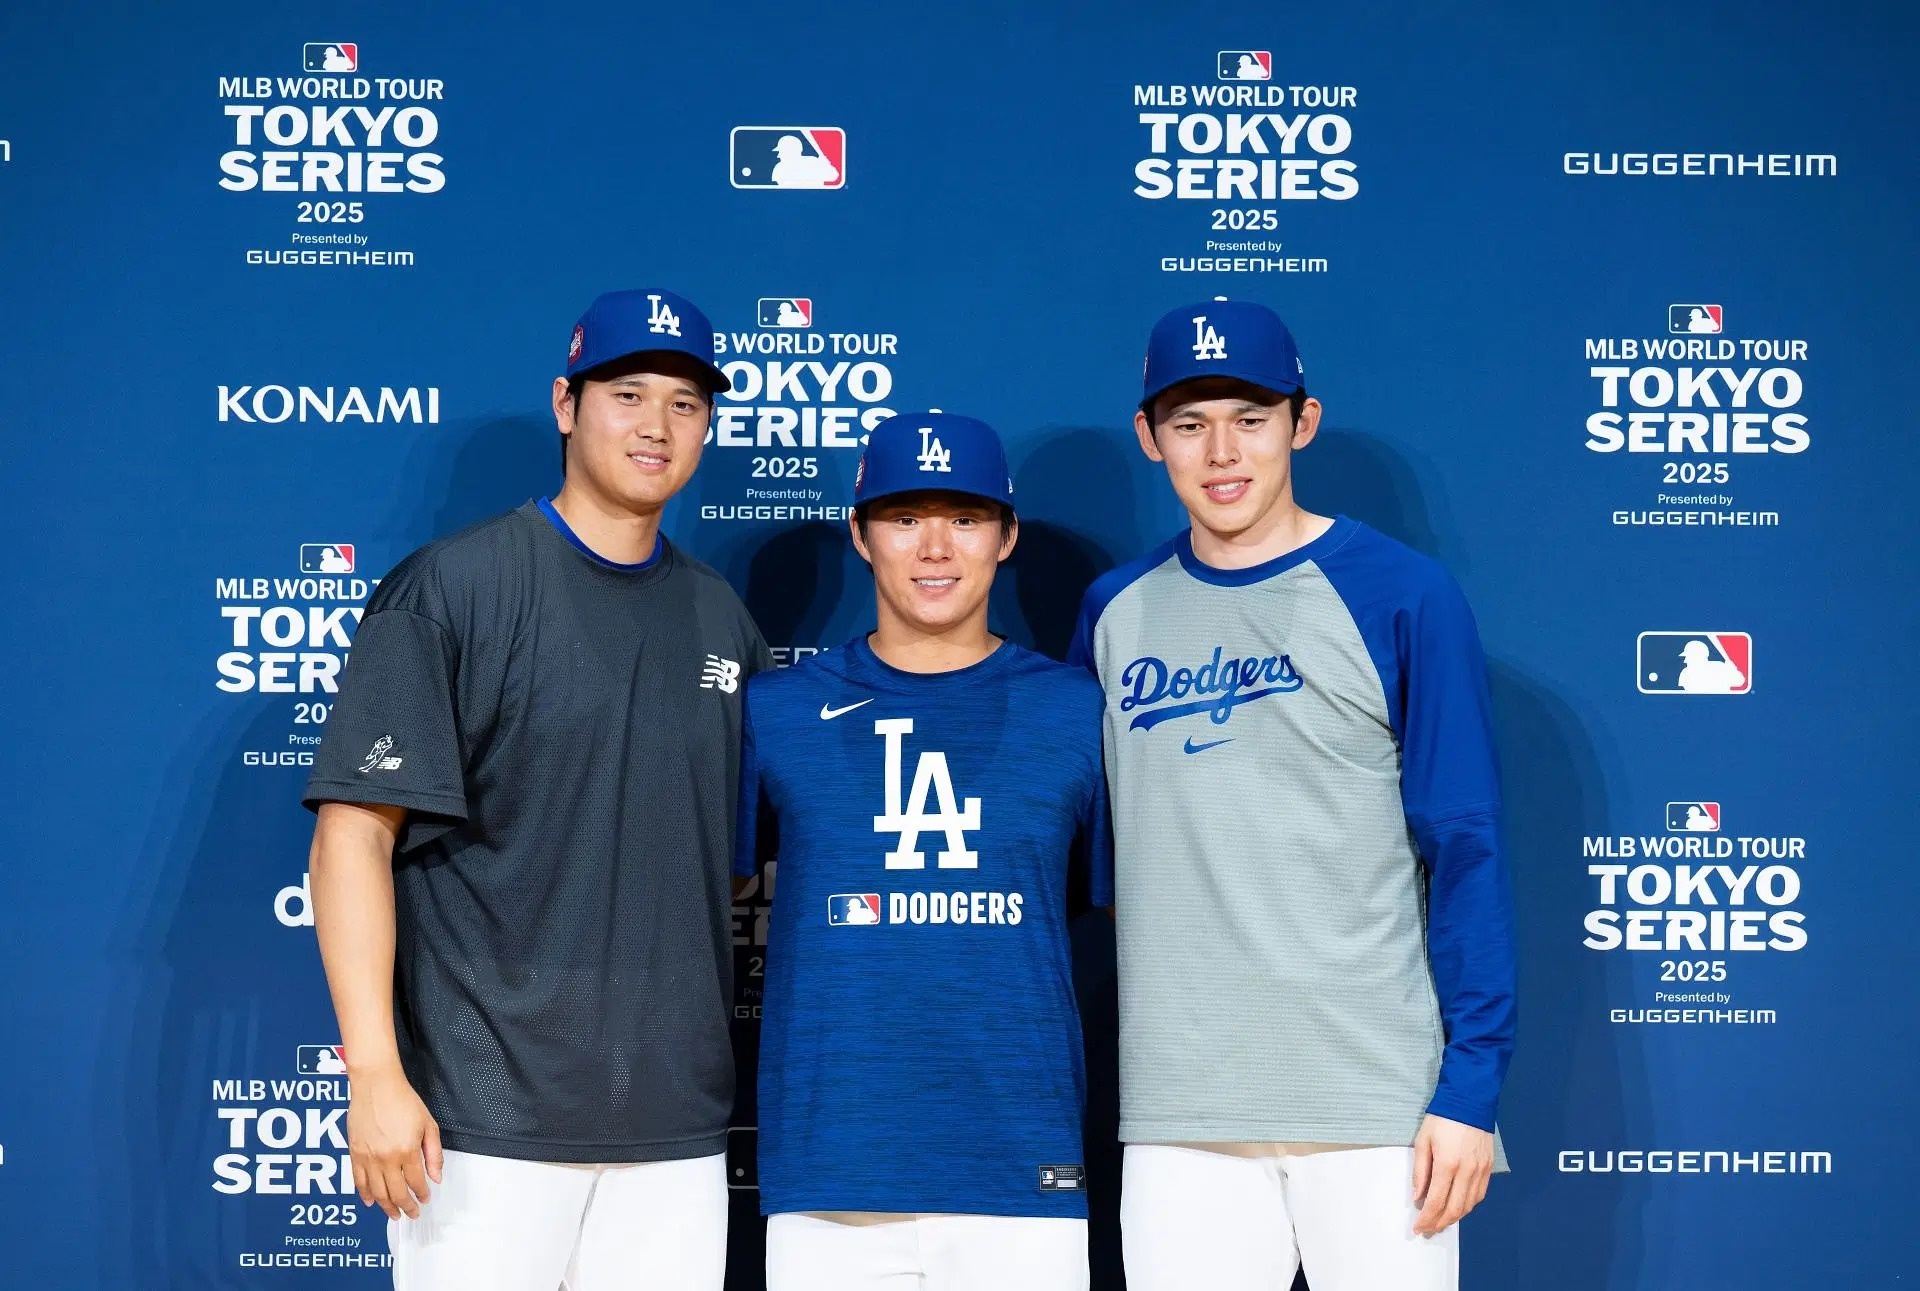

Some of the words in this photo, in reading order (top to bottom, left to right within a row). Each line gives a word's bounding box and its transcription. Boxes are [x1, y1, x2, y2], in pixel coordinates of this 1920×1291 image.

[220, 77, 272, 97] MLB
[277, 78, 370, 98] WORLD
[375, 79, 443, 99] TOUR
[1135, 85, 1187, 105] MLB
[1191, 86, 1284, 106] WORLD
[1289, 86, 1357, 107] TOUR
[225, 105, 438, 147] TOKYO
[1140, 113, 1351, 154] TOKYO
[219, 151, 445, 193] SERIES
[1564, 153, 1836, 175] GUGGENHEIM
[1134, 159, 1359, 200] SERIES
[298, 202, 363, 223] 2025
[1212, 209, 1278, 230] 2025
[293, 233, 351, 243] Presented
[354, 234, 367, 246] by
[1207, 241, 1265, 251] Presented
[1268, 241, 1281, 252] by
[247, 251, 413, 265] GUGGENHEIM
[1162, 258, 1327, 272] GUGGENHEIM
[647, 294, 682, 337] LA
[731, 333, 825, 354] WORLD
[829, 333, 898, 354] TOUR
[1192, 316, 1228, 360] LA
[1586, 339, 1638, 359] MLB
[1643, 339, 1735, 360] WORLD
[1740, 340, 1807, 360] TOUR
[715, 360, 892, 402] OKYO
[1591, 367, 1802, 408] TOKYO
[218, 385, 438, 423] KONAMI
[1585, 412, 1810, 453] SERIES
[917, 427, 952, 472] LA
[751, 457, 818, 478] 2025
[1663, 463, 1729, 483] 2025
[746, 488, 806, 499] Presented
[808, 489, 822, 501] by
[1658, 494, 1716, 504] Presented
[1720, 495, 1733, 506] by
[701, 506, 855, 520] GUGGENHEI
[1613, 511, 1778, 525] GUGGENHEIM
[216, 578, 269, 599] MLB
[274, 578, 368, 600] WORLD
[221, 606, 365, 647] TOK
[215, 652, 349, 693] SER
[1120, 646, 1304, 727] Dodgers
[294, 702, 333, 724] 20
[289, 734, 322, 745] Prese
[873, 718, 982, 870] LA
[1584, 837, 1635, 857] MLB
[1640, 837, 1732, 857] WORLD
[1738, 837, 1805, 858] TOUR
[1589, 865, 1800, 905] TOKYO
[889, 891, 1024, 926] DODGERS
[1583, 910, 1807, 951] SERIES
[1661, 961, 1726, 981] 2025
[1656, 992, 1714, 1002] Presented
[1717, 993, 1730, 1004] by
[1611, 1010, 1776, 1023] GUGGENHEIM
[212, 1080, 265, 1100] MLB
[270, 1080, 351, 1101] WORL
[217, 1108, 349, 1148] TOK
[1559, 1151, 1831, 1173] GUGGENHEIM
[211, 1153, 356, 1194] SERI
[290, 1204, 357, 1225] 2025
[285, 1236, 345, 1247] Presented
[347, 1236, 361, 1248] by
